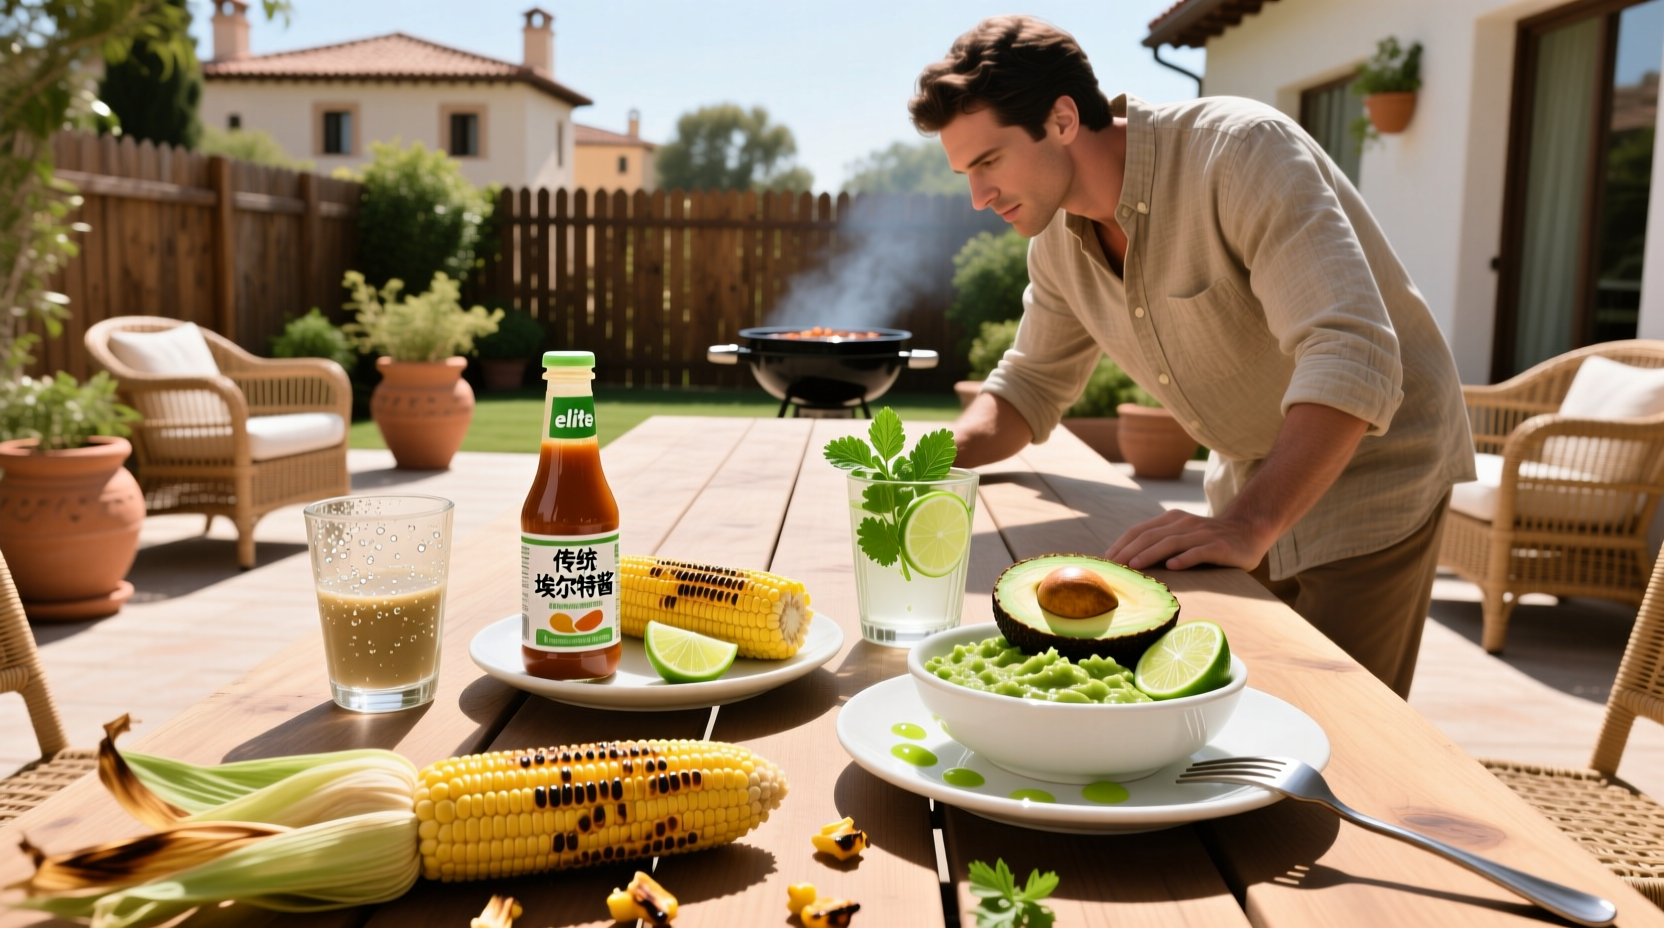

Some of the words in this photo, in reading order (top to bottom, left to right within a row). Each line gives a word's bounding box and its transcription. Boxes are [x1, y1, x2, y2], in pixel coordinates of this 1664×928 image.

[555, 408, 593, 428] elite
[553, 547, 598, 573] 传统
[534, 570, 614, 599] 埃尔特酱
